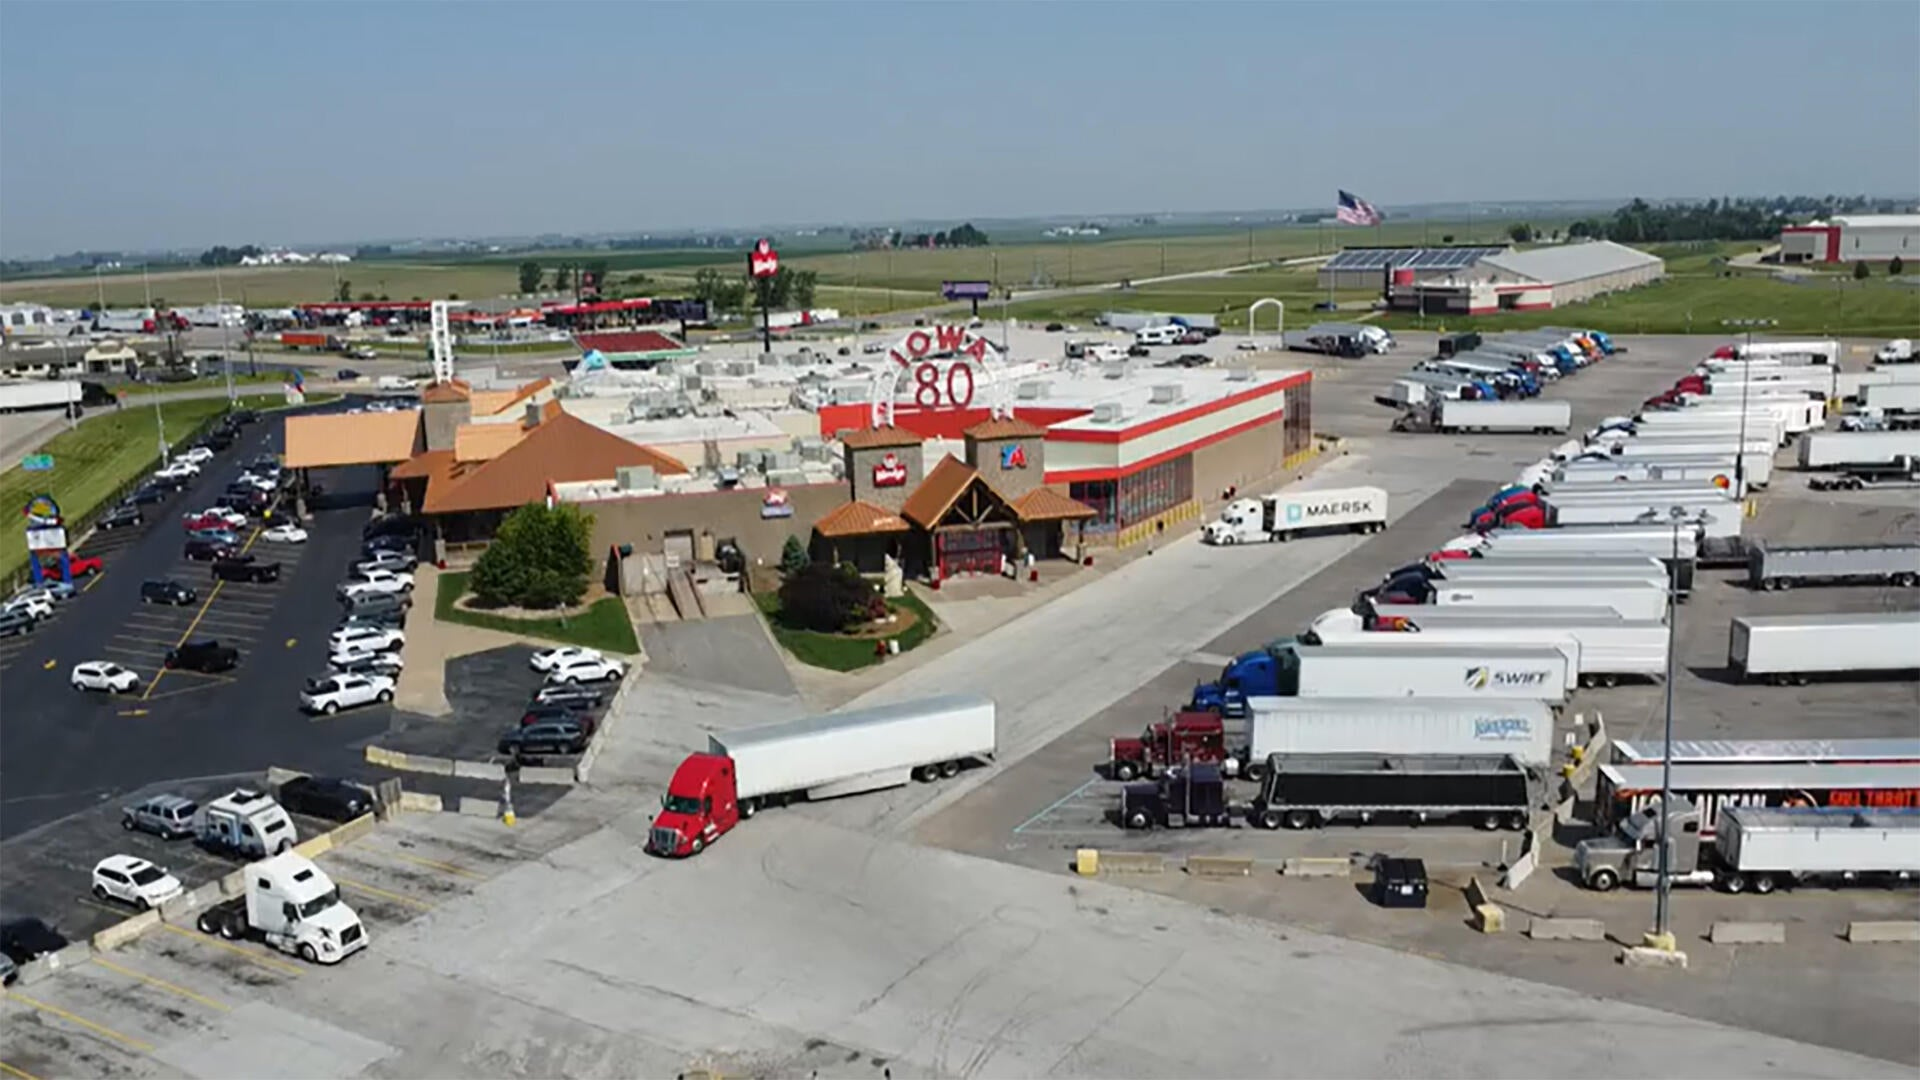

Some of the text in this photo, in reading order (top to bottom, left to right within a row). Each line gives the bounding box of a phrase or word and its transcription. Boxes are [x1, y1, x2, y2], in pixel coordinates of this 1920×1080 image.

[889, 324, 986, 369] IOWA
[915, 361, 974, 410] 80
[1306, 501, 1372, 517] MAERSK
[1494, 671, 1547, 684] SWIFT
